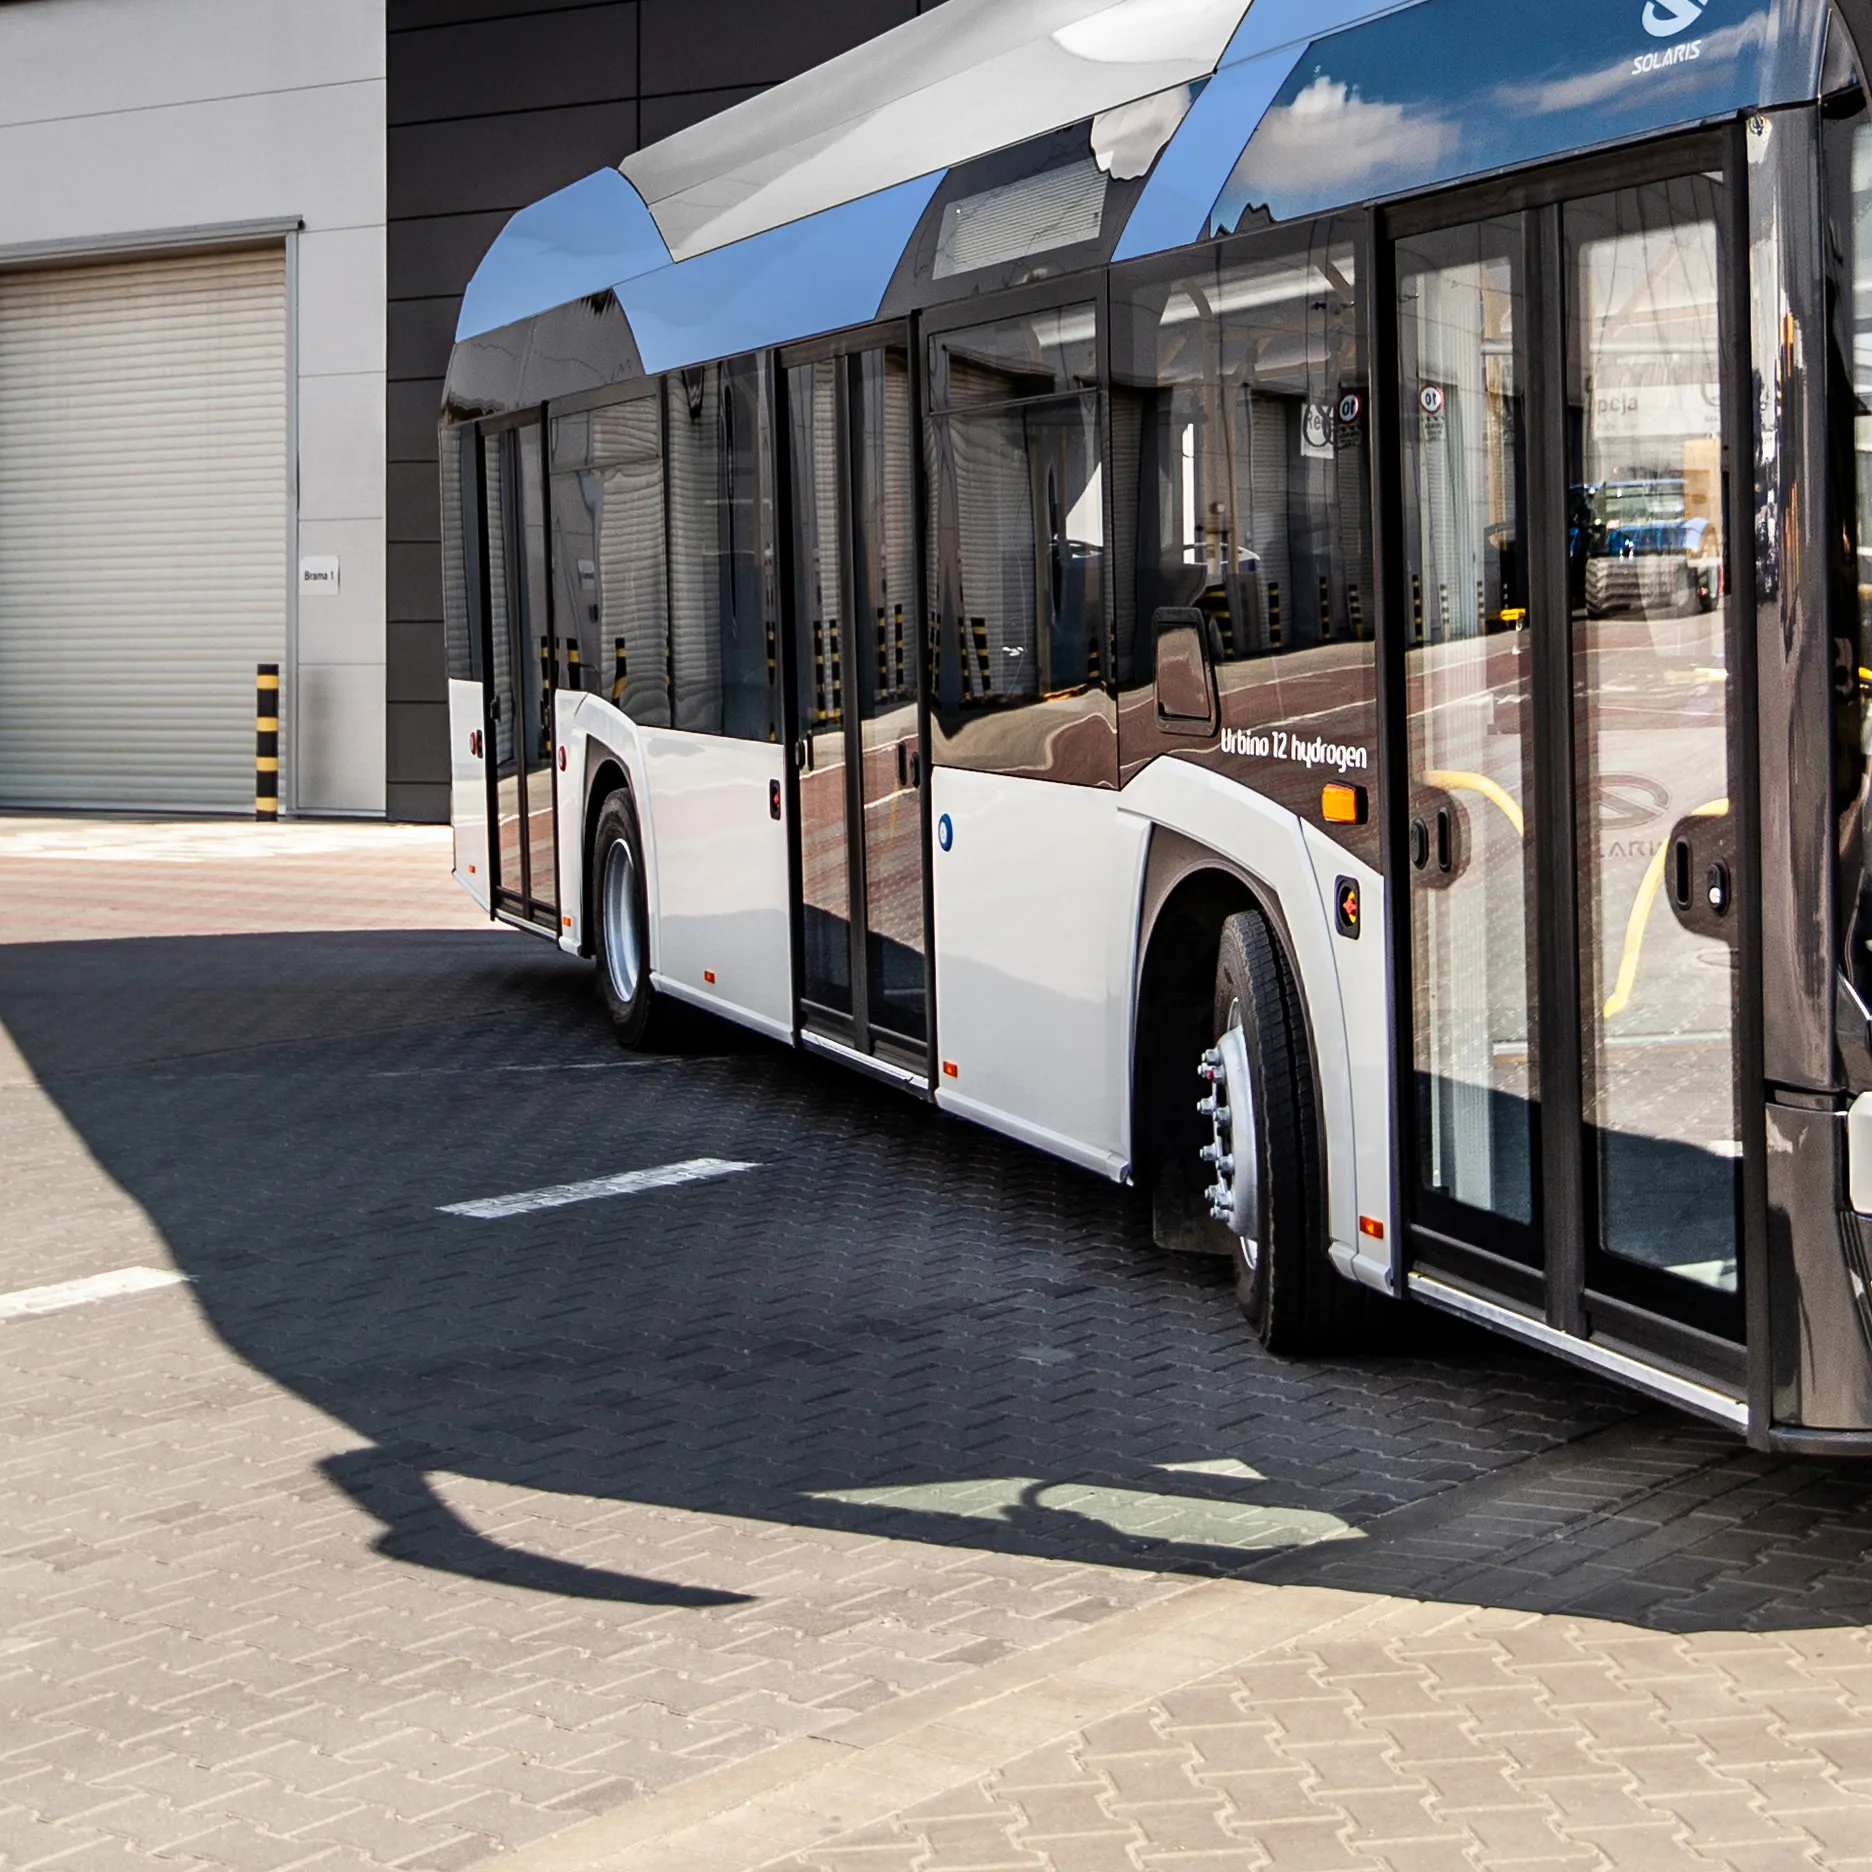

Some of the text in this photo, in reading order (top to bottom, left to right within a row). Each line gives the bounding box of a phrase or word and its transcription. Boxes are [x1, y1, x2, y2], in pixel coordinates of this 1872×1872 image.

[1631, 40, 1702, 75] SOLARIS
[1221, 728, 1367, 773] Urbino 12 hydrogen
